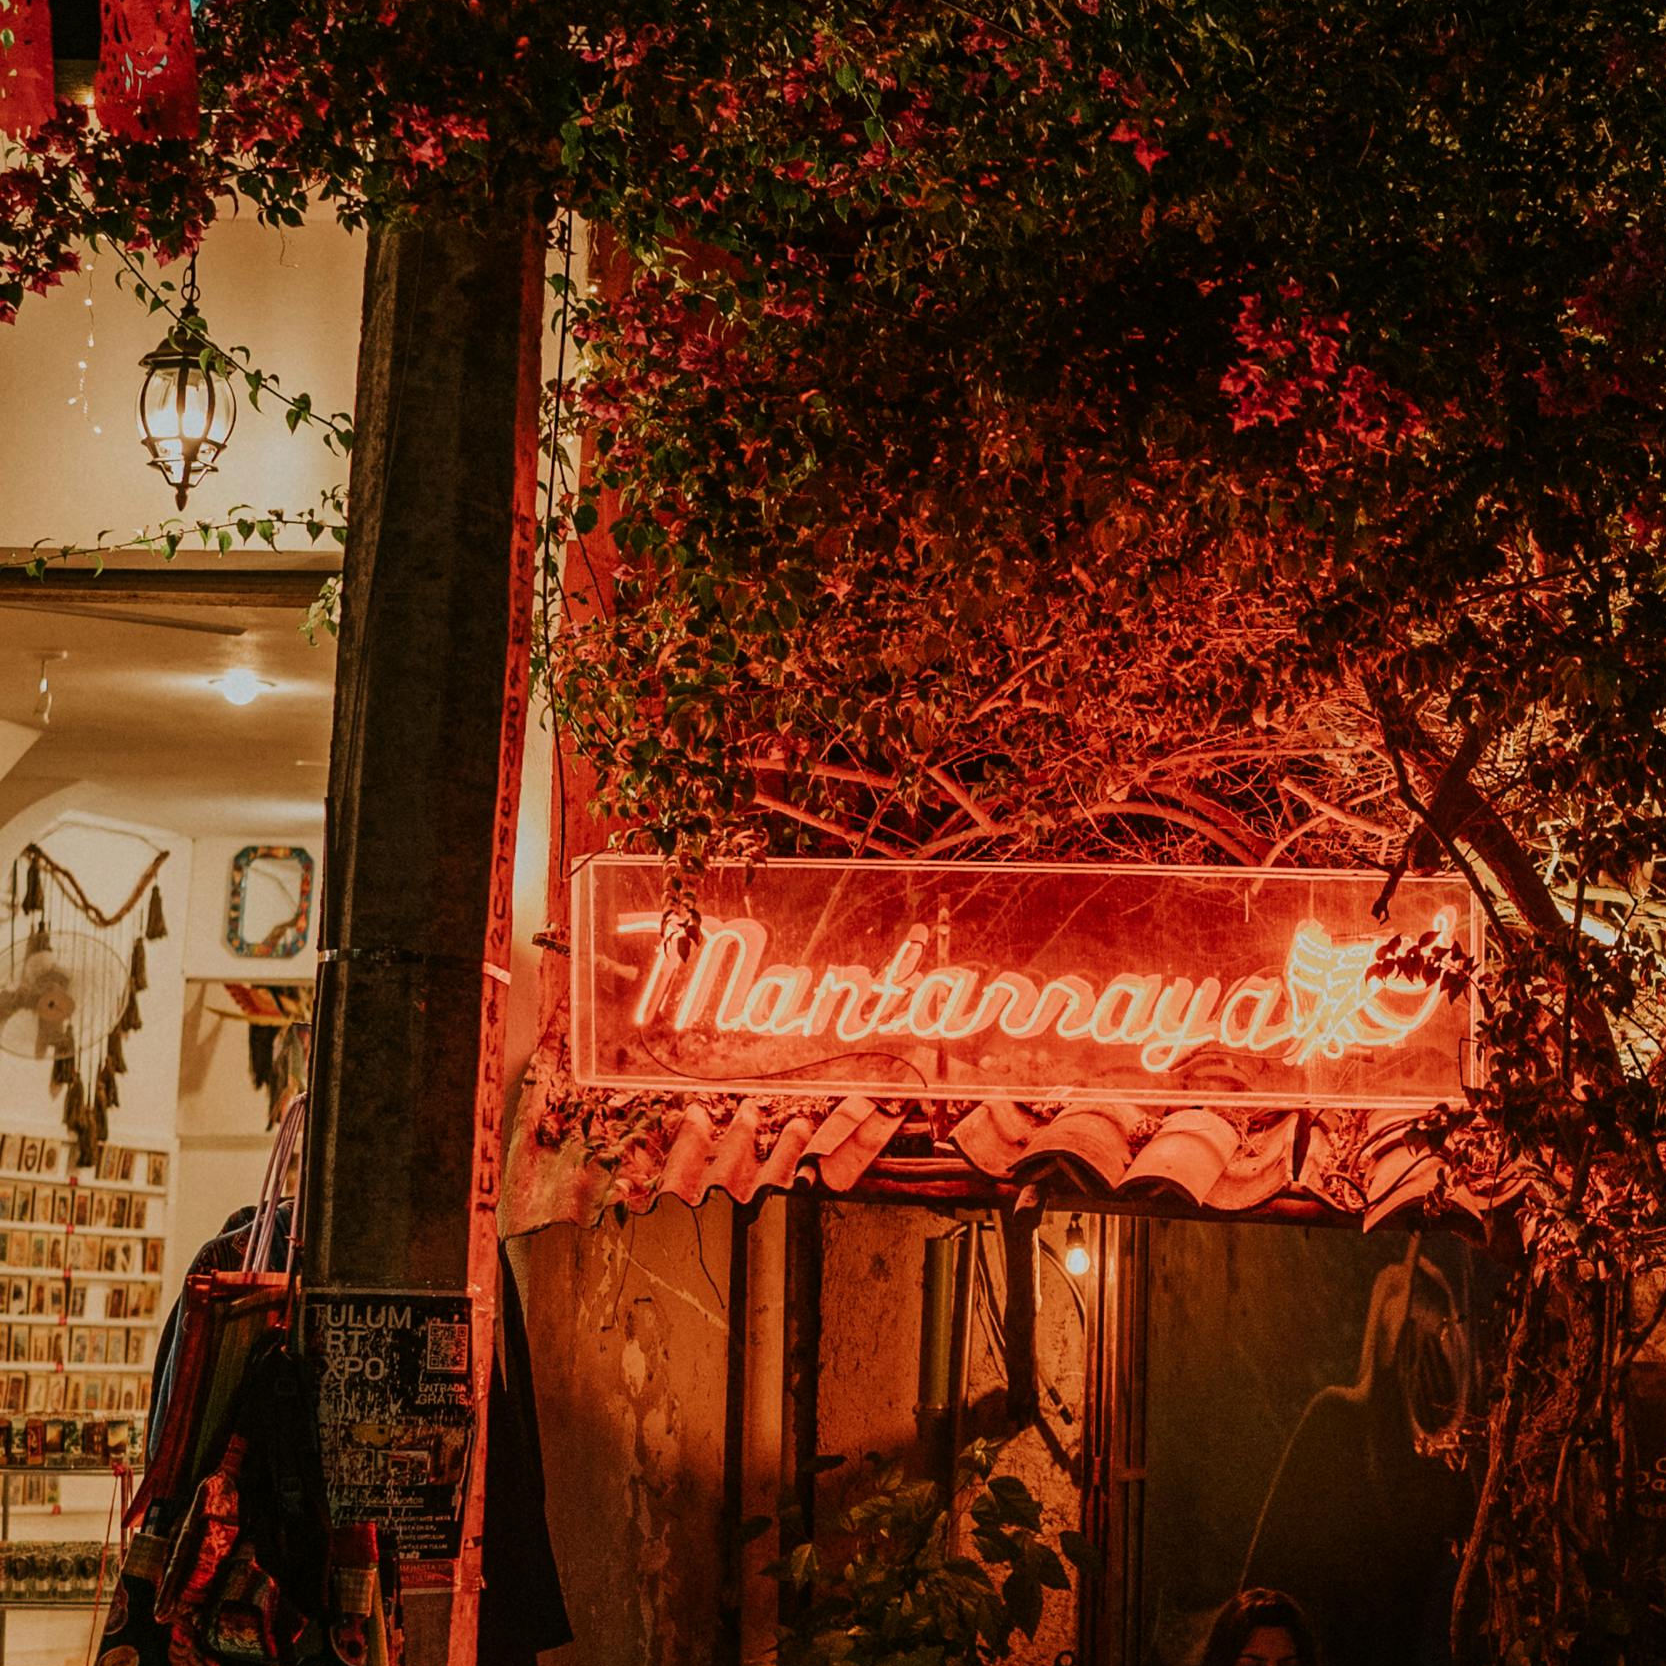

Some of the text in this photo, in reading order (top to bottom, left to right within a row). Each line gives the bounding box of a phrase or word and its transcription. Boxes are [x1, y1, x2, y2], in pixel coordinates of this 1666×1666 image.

[617, 911, 1297, 1074] Mantarraya
[311, 1302, 412, 1329] TULUM
[326, 1329, 369, 1356] RT
[321, 1356, 386, 1381] XPO
[418, 1383, 467, 1393] ENTRADA
[418, 1393, 467, 1405] GRATIS
